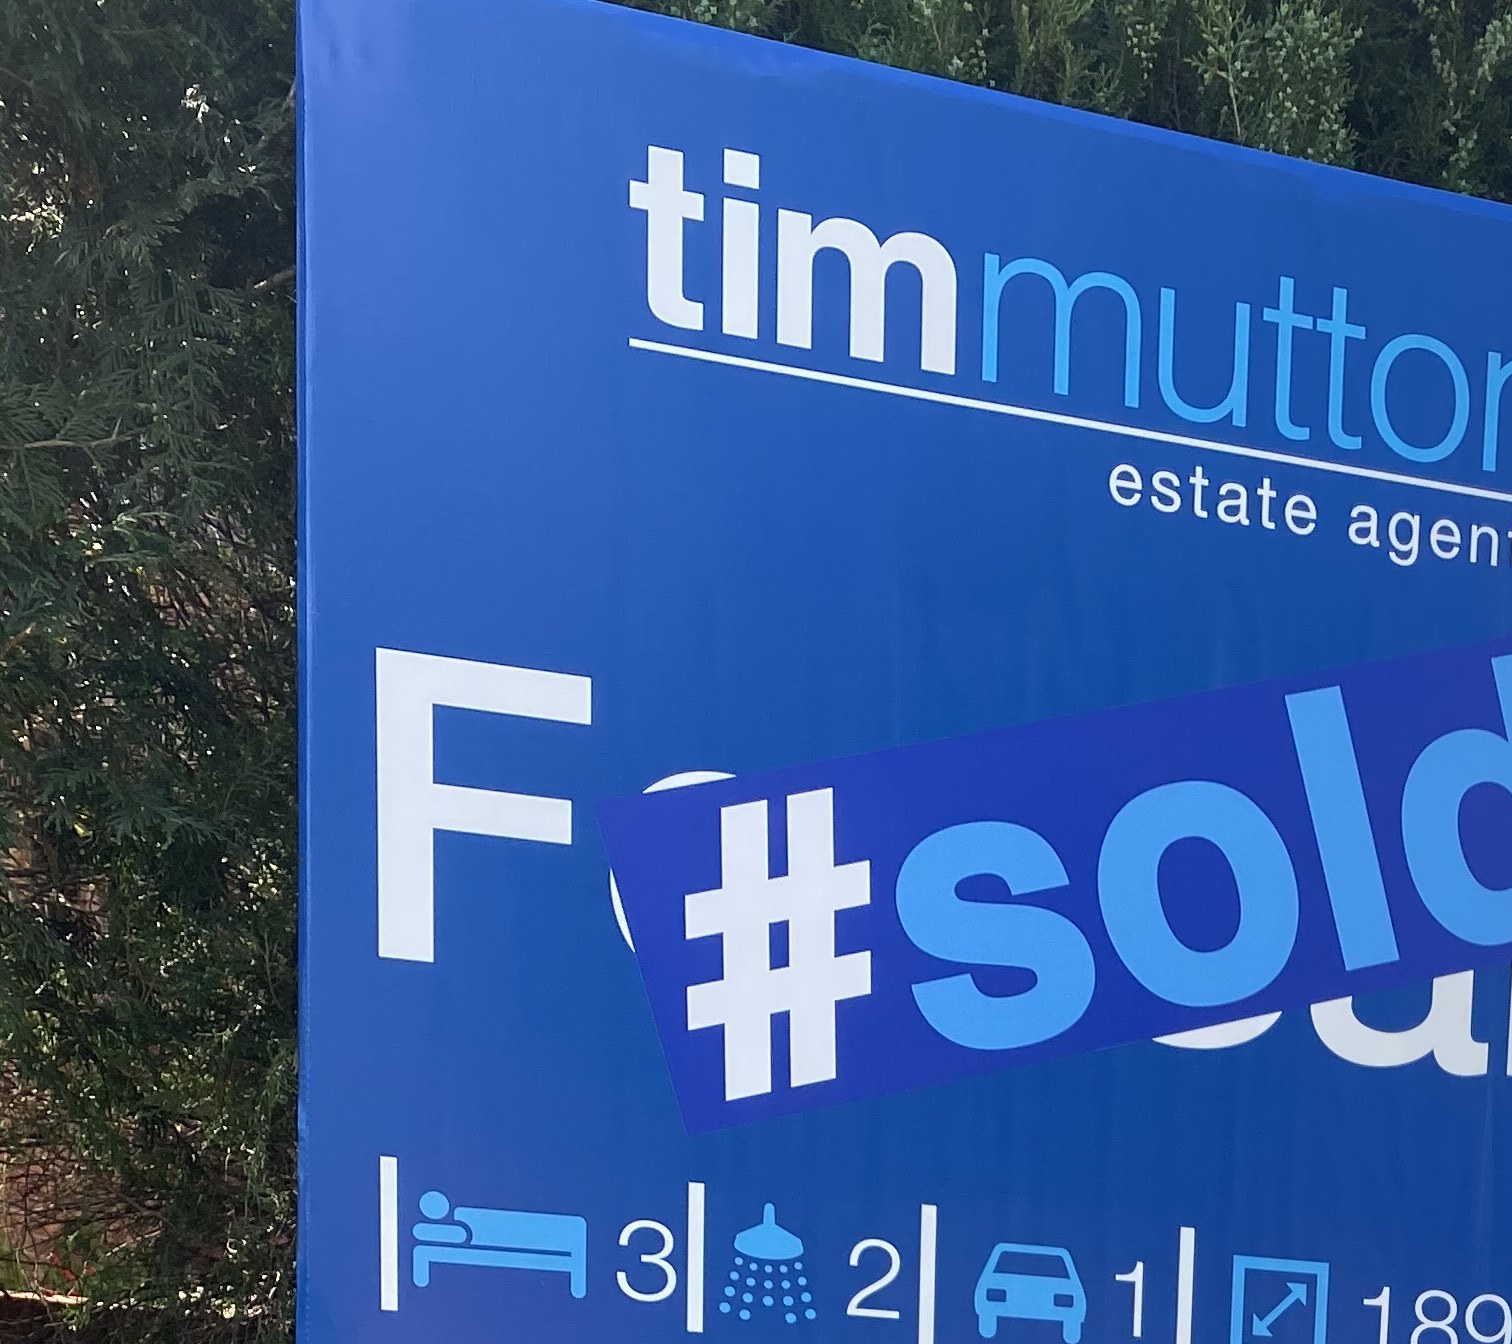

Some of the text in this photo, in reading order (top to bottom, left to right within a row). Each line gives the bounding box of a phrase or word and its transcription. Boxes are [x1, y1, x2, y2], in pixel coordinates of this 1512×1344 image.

[1108, 464, 1318, 537] estate
[616, 1219, 677, 1303] 3
[846, 1238, 901, 1320] 2
[1115, 1260, 1145, 1338] 1
